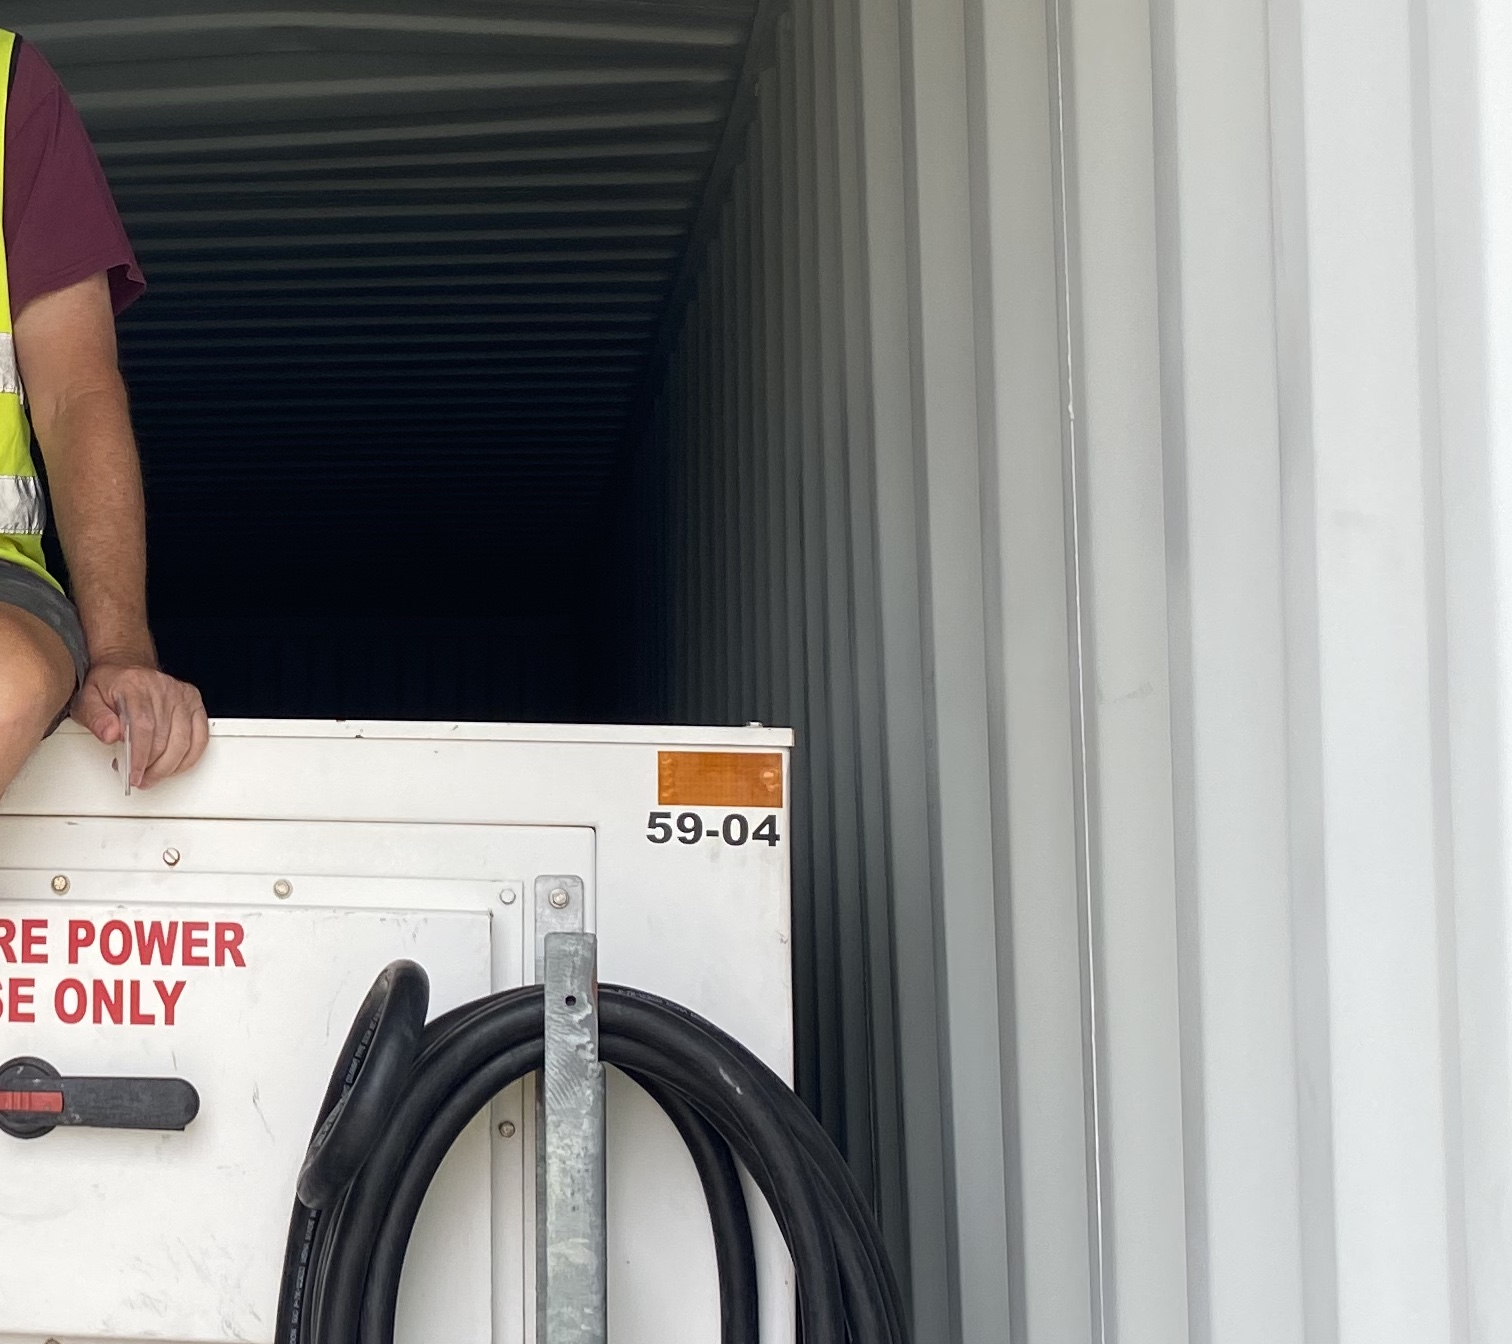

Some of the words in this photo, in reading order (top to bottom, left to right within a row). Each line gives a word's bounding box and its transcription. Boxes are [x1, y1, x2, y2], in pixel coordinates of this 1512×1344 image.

[646, 811, 781, 846] 59-04
[68, 919, 247, 968] POWER
[54, 977, 187, 1026] ONLY
